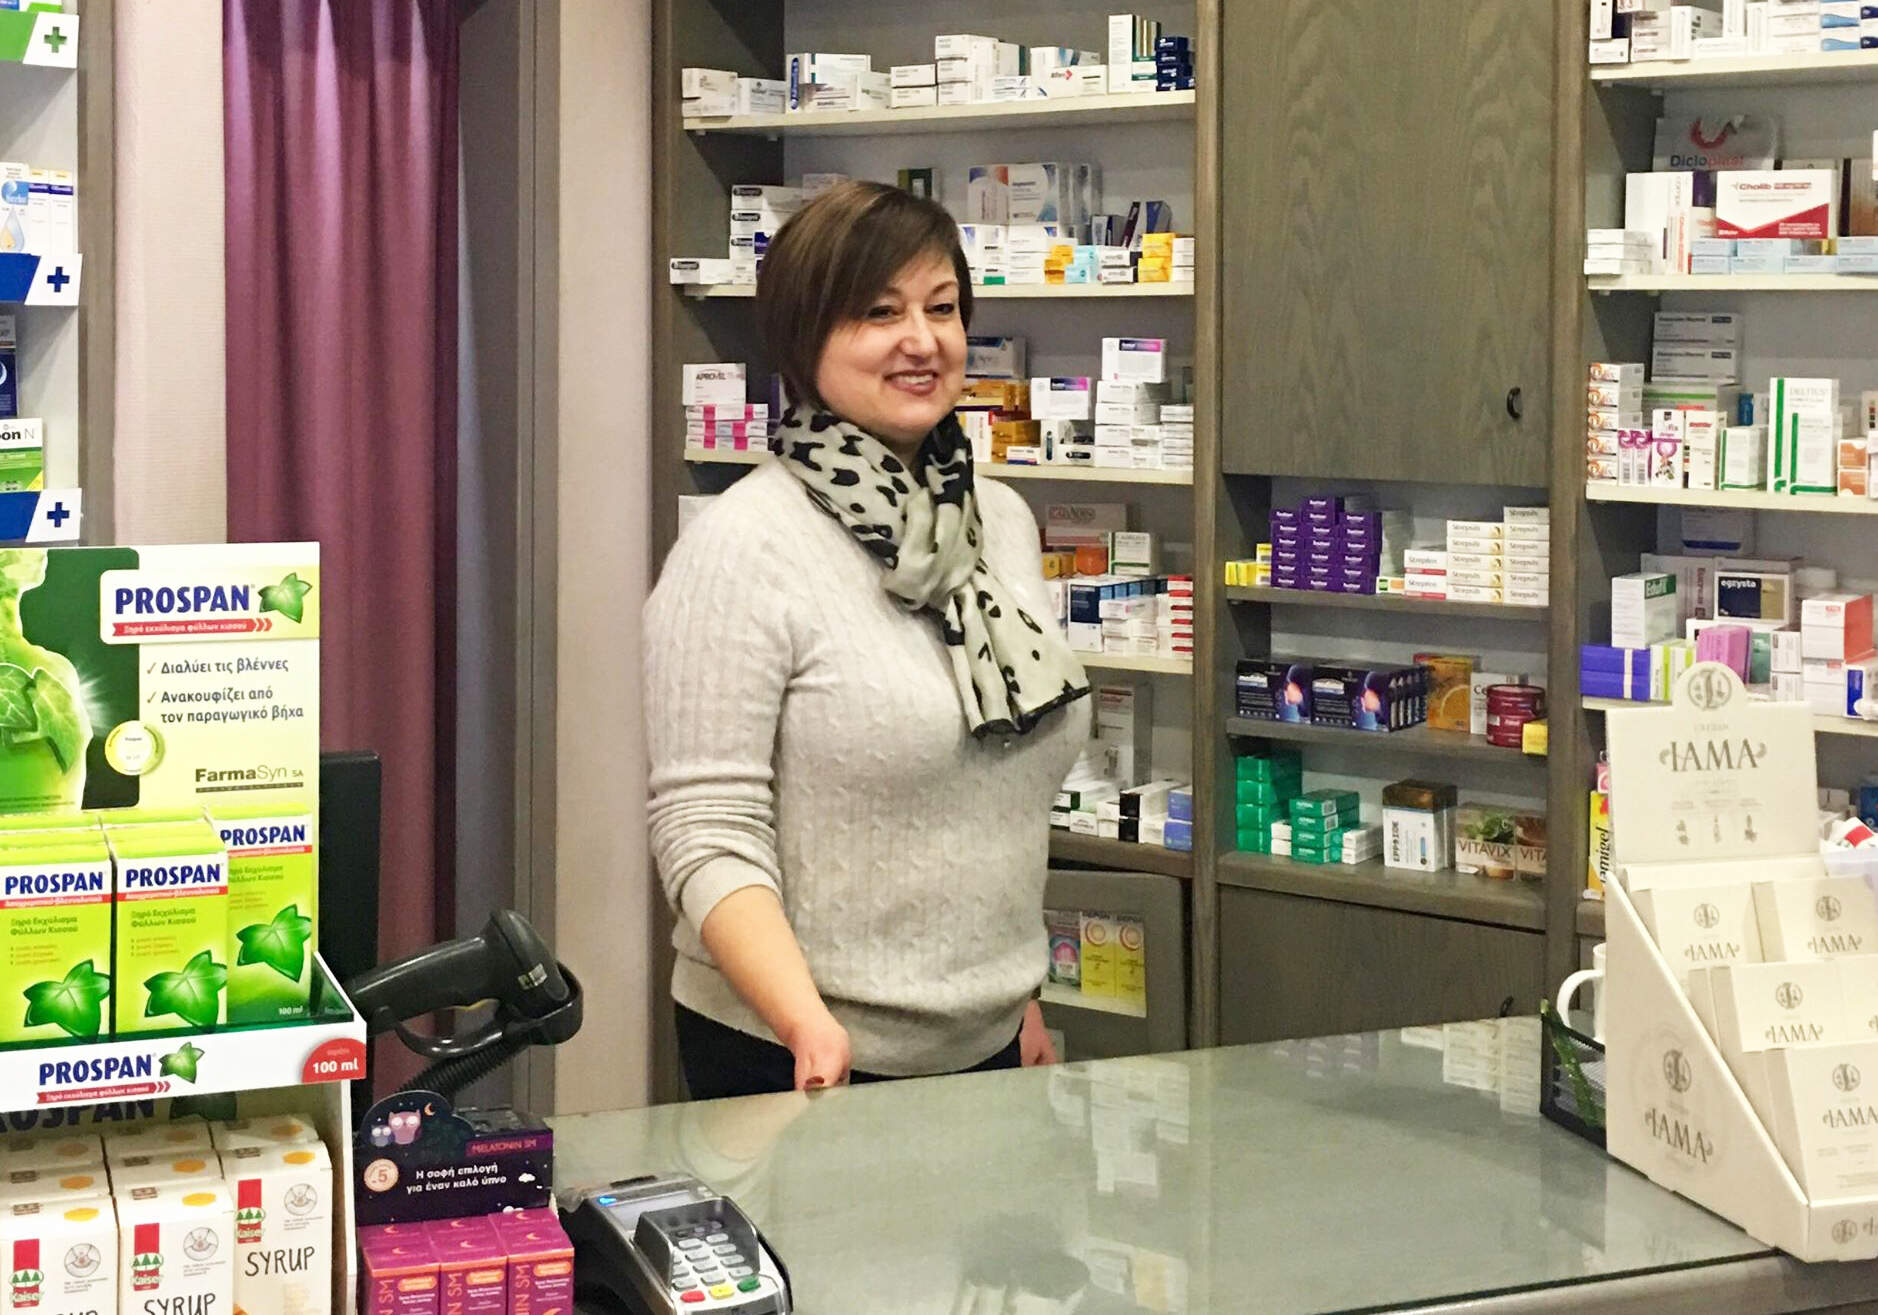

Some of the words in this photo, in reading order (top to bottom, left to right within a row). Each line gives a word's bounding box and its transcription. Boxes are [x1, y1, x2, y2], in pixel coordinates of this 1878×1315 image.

[0, 431, 22, 441] on
[24, 428, 35, 440] N
[115, 585, 250, 615] PROSPAN
[161, 662, 211, 674] Διαλύει
[215, 661, 233, 673] τις
[237, 658, 289, 673] βλέννες
[161, 688, 245, 703] Ανακουφίζει
[249, 687, 273, 701] από
[161, 713, 182, 724] τον
[187, 708, 268, 724] παραγωγικό
[271, 706, 304, 720] βήχα
[195, 765, 288, 783] FarmaSyn
[220, 824, 306, 846] PROSPAN
[1458, 838, 1512, 857] VITAVIX
[5, 871, 103, 895] PROSPAN
[126, 864, 221, 888] PROSPAN
[39, 1053, 152, 1086] PROSPAN
[313, 1059, 338, 1075] 100
[341, 1056, 359, 1073] ml
[472, 1141, 523, 1152] MELATONIN
[415, 1171, 424, 1179] Η
[427, 1168, 455, 1179] σοφή
[406, 1184, 422, 1194] για
[425, 1181, 450, 1191] έναν
[453, 1178, 479, 1189] καλό
[482, 1176, 506, 1186] ύπνο
[245, 1246, 315, 1277] SYRUP
